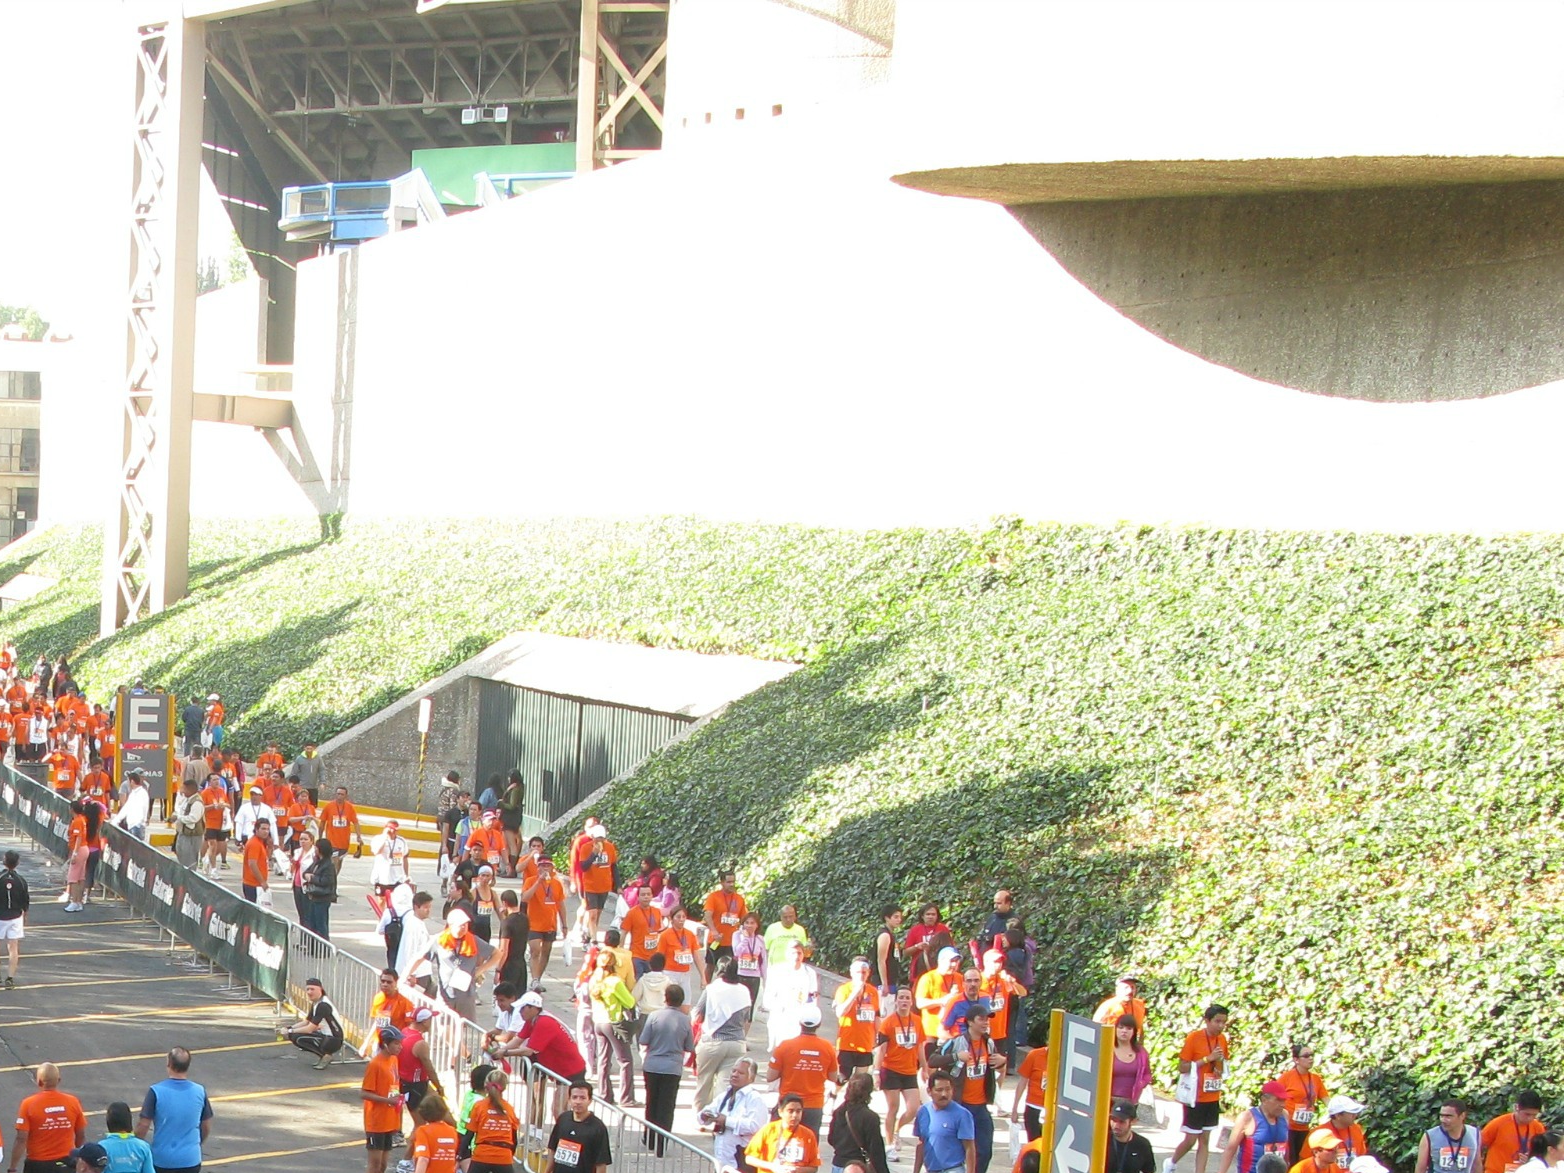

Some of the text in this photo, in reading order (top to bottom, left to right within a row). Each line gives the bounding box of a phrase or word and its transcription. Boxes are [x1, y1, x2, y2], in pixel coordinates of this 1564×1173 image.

[129, 698, 160, 740] E
[1063, 1021, 1095, 1106] E
[1441, 1156, 1464, 1167] 124
